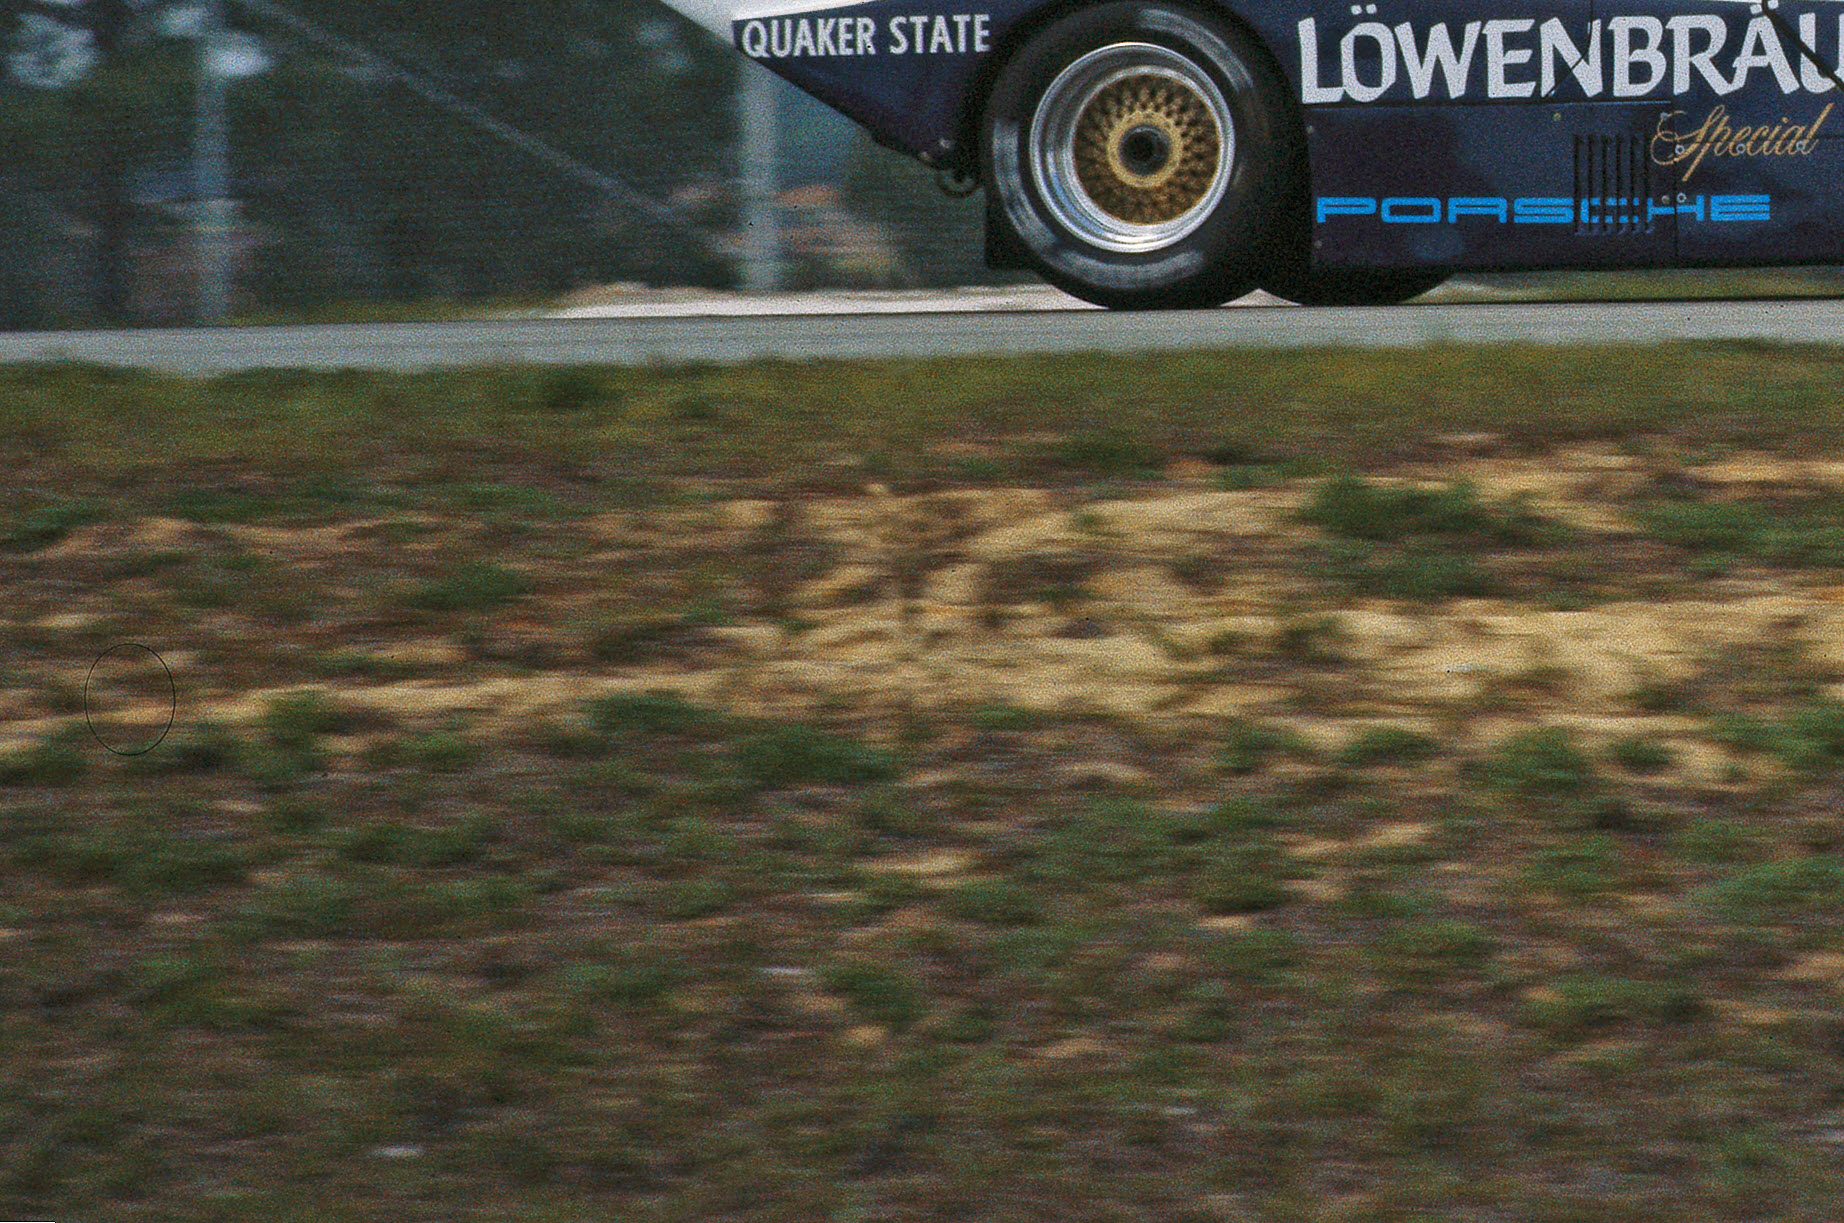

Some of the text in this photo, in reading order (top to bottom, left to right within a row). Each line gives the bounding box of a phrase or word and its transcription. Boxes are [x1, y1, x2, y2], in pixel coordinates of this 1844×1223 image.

[742, 14, 991, 58] QUAKER STATE
[1650, 103, 1834, 182] Special
[1316, 194, 1771, 225] PORSCHE
